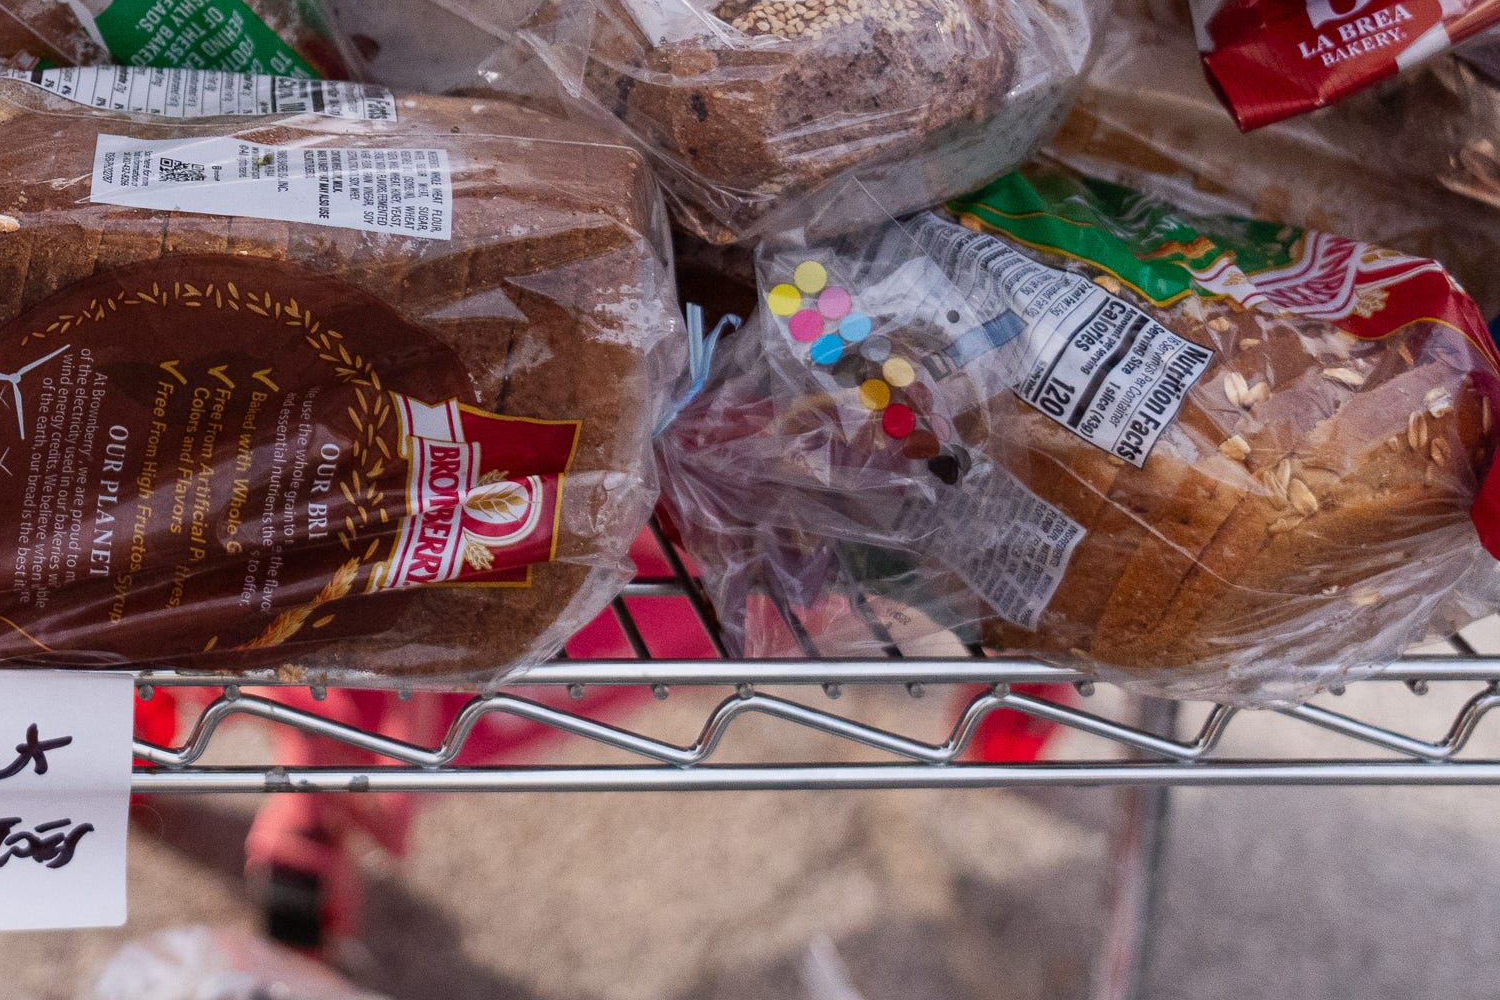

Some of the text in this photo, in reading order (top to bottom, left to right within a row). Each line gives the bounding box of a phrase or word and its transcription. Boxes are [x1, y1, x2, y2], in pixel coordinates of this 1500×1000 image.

[164, 6, 225, 64] OF THESE
[1297, 1, 1413, 60] LA BREA
[1320, 26, 1402, 67] BAKERY
[402, 205, 417, 230] WHEAT
[1039, 300, 1127, 417] Calories 120
[1132, 324, 1165, 361] Serving
[1144, 341, 1176, 376] Servings
[1120, 354, 1144, 375] Size
[1134, 372, 1154, 387] Per
[151, 380, 174, 417] Free
[1095, 387, 1116, 411] slice
[1109, 382, 1143, 428] Container
[1116, 346, 1208, 461] Nutrition Facts
[144, 419, 166, 459] From
[1080, 409, 1105, 439] (43g)
[12, 376, 56, 577] of the earth, our bread is the best
[29, 352, 76, 581] wind energy credits. We believe when
[134, 459, 157, 500] High
[167, 385, 210, 535] Colors and Flavors
[187, 387, 232, 544] Free From Artificial
[224, 390, 267, 537] Baked with Whole
[87, 423, 130, 578] OUR PLANET
